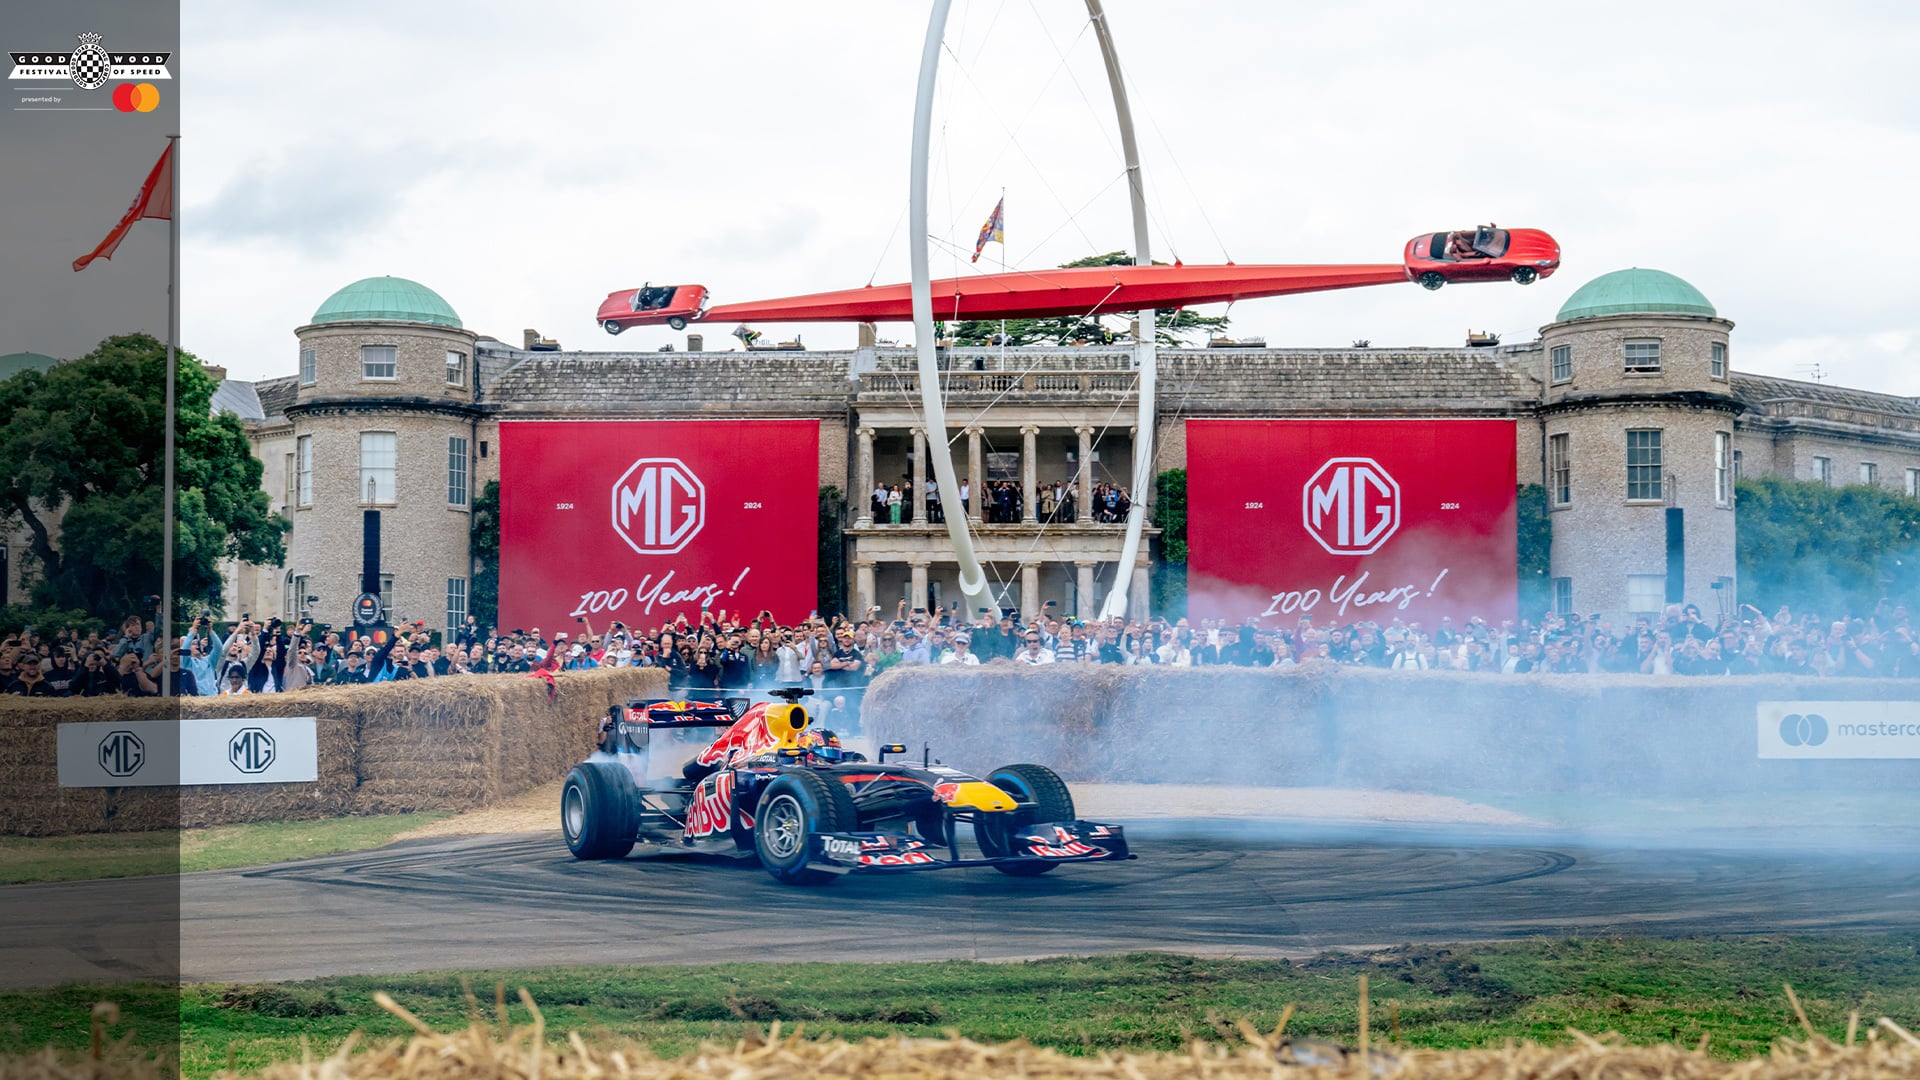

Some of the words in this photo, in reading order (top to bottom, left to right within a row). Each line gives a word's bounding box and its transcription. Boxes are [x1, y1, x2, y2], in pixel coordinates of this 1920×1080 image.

[556, 502, 574, 510] 1924
[620, 467, 697, 545] MG
[1312, 467, 1391, 546] MG
[1440, 502, 1460, 510] 2024
[569, 588, 628, 617] 100
[1261, 589, 1321, 617] 100
[103, 735, 141, 773] MG
[233, 732, 271, 769] MG
